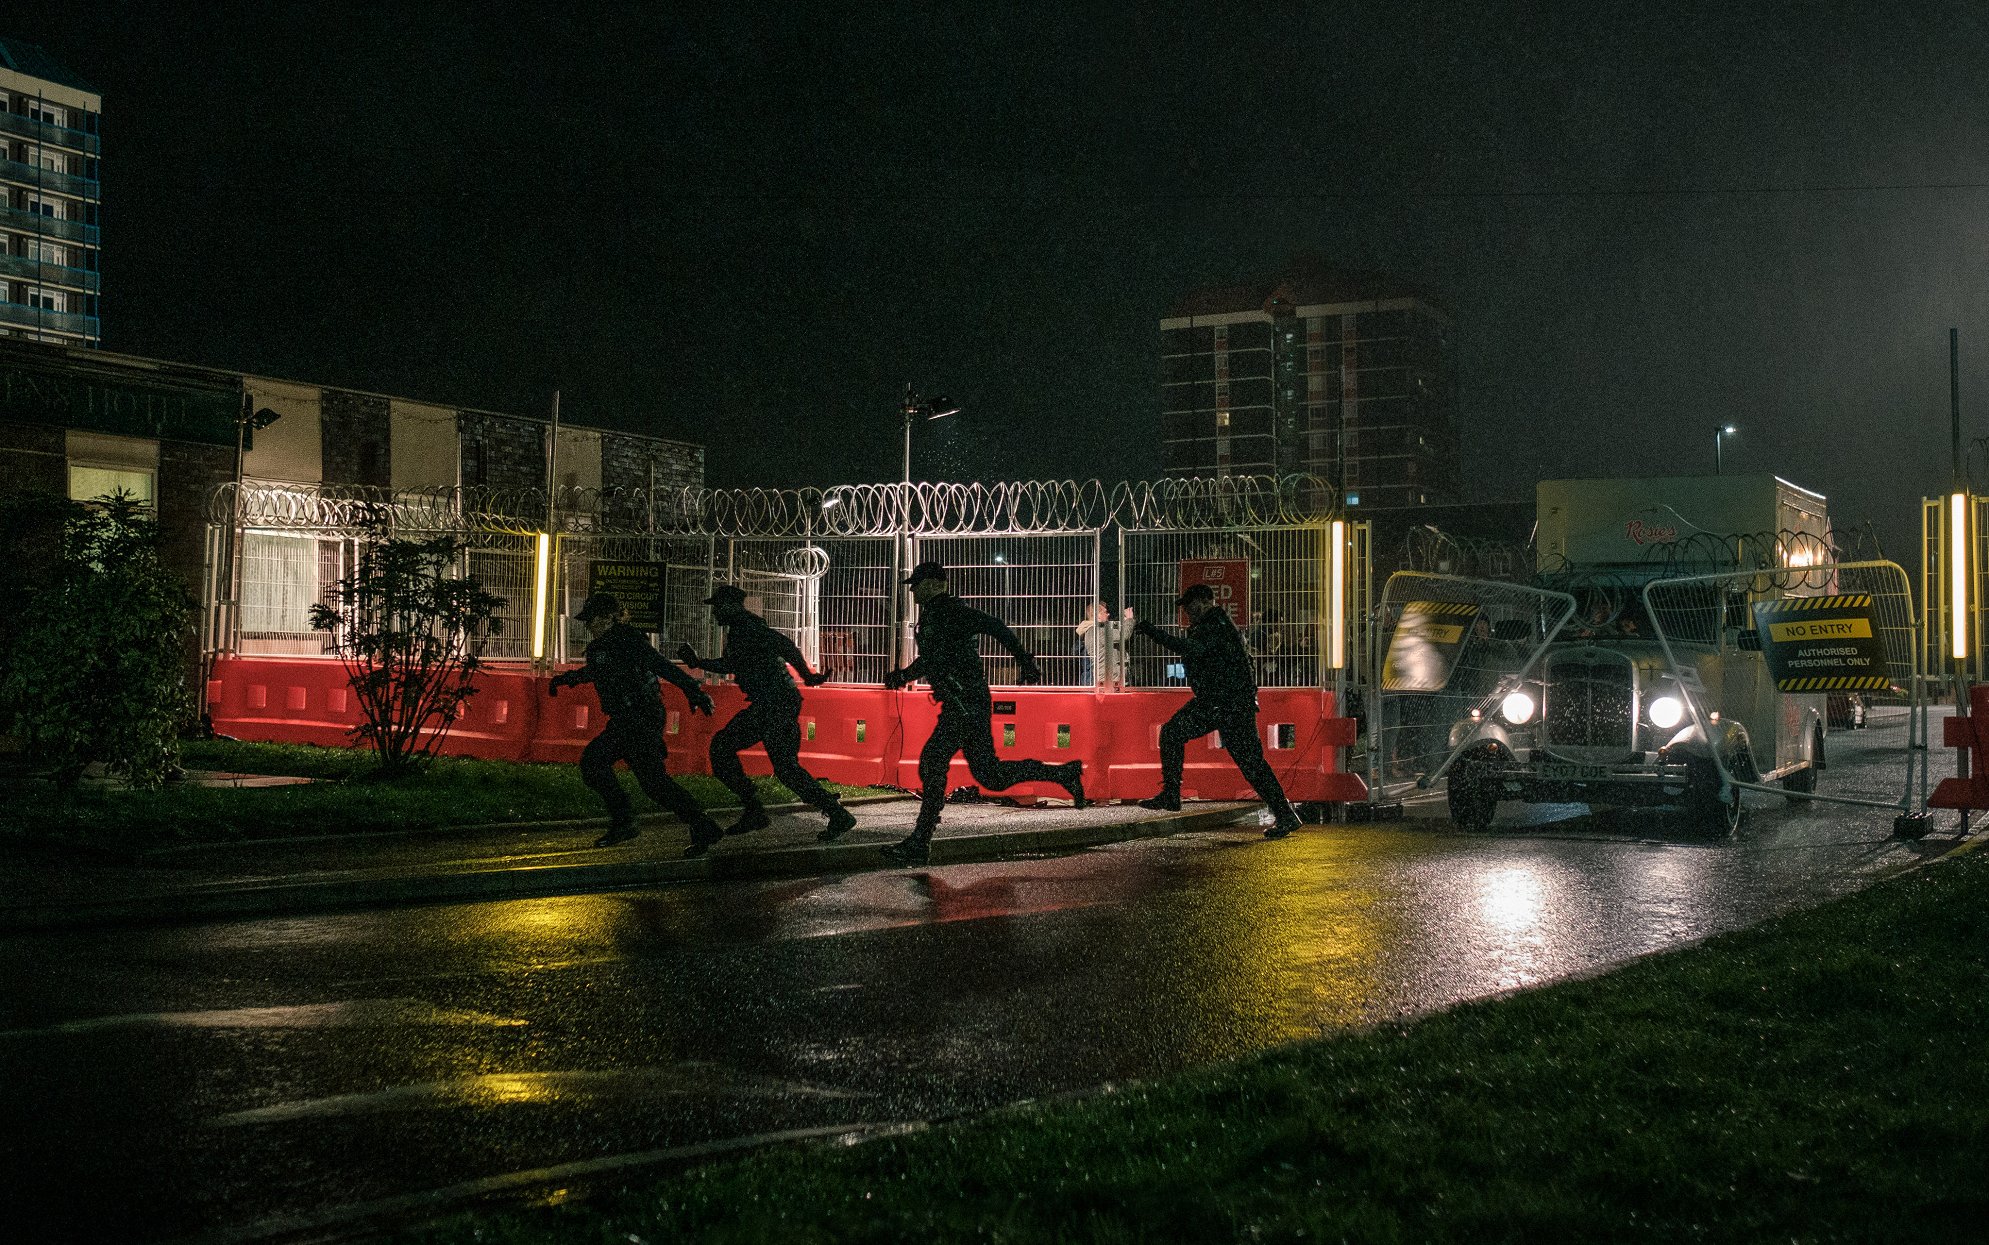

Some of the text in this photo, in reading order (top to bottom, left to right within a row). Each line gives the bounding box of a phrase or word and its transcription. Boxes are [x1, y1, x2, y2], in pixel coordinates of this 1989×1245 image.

[597, 565, 659, 577] WARNING
[627, 592, 659, 600] CIRCUIT
[1786, 623, 1853, 636] NO ENTRY
[1797, 647, 1858, 657] AUTHORISED
[1788, 657, 1871, 668] PERSONNEL ONLY
